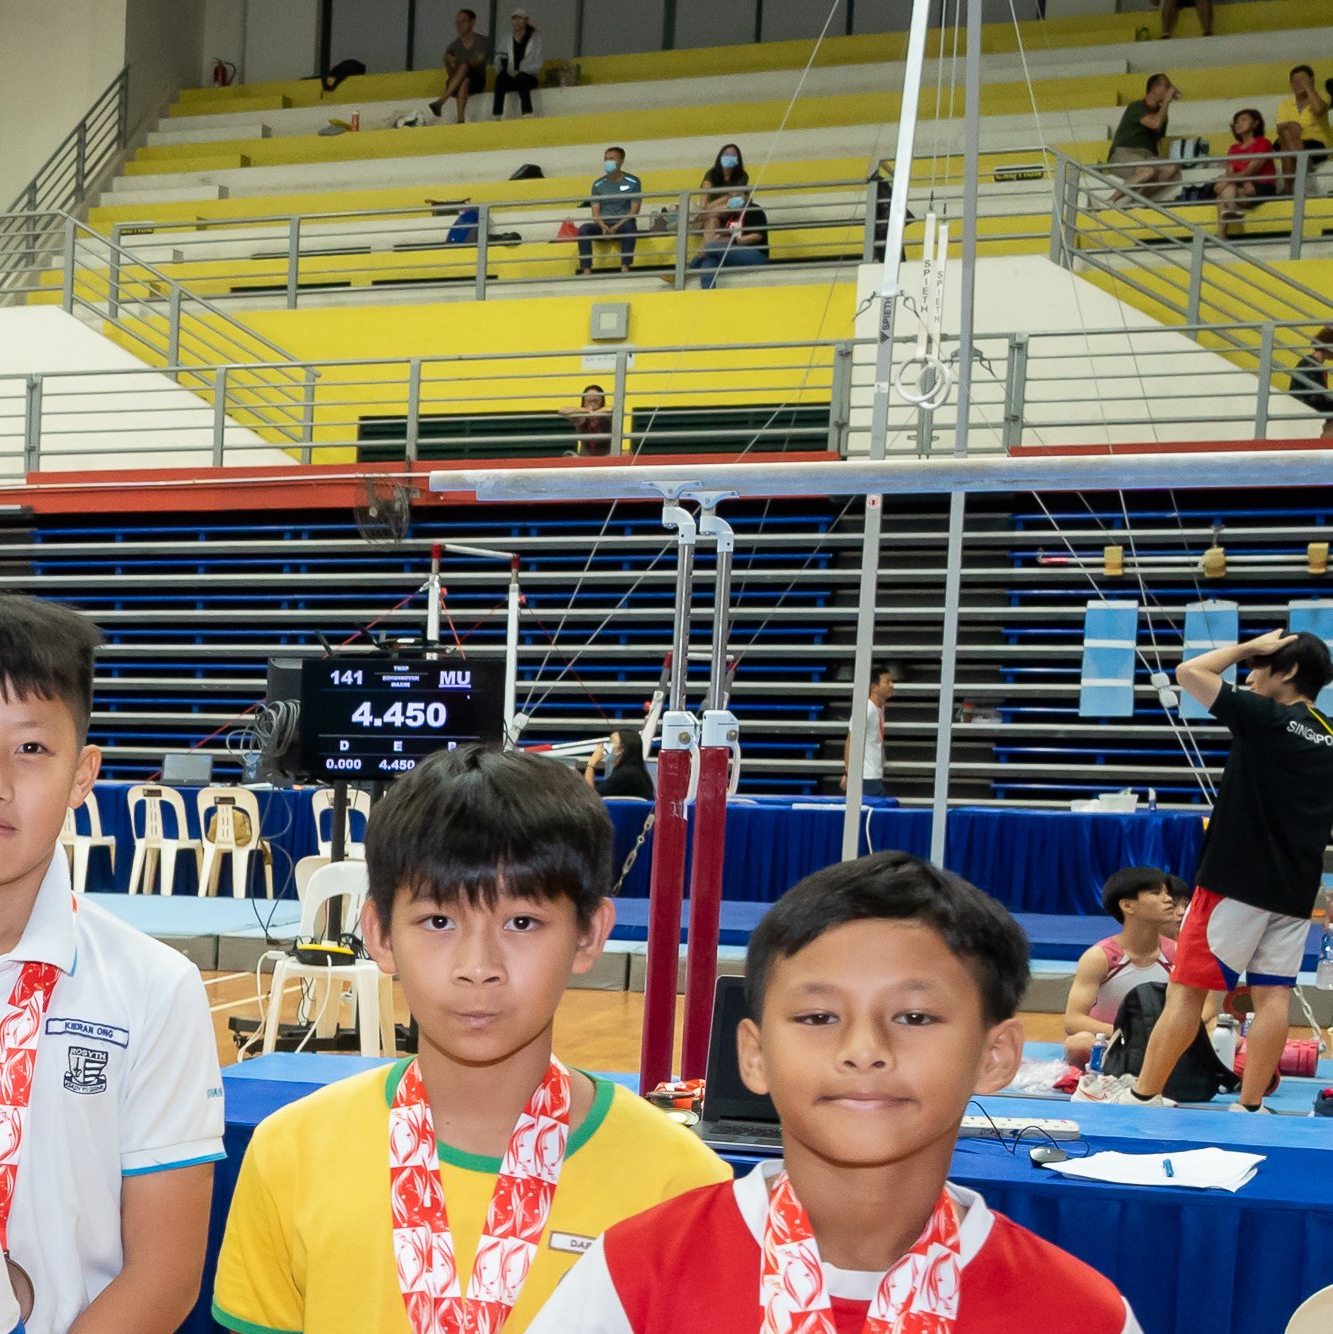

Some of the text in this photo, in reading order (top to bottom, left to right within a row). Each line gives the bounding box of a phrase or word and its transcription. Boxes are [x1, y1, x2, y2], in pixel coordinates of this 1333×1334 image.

[921, 260, 931, 313] SPIETH
[330, 670, 363, 685] 141
[439, 671, 471, 685] MU
[351, 701, 447, 728] 4.450
[339, 740, 350, 751] D
[393, 740, 403, 752] E
[325, 758, 362, 771] 0.000
[378, 759, 415, 771] 4.450
[97, 1027, 114, 1038] ONG
[71, 1048, 106, 1060] ROSYTH
